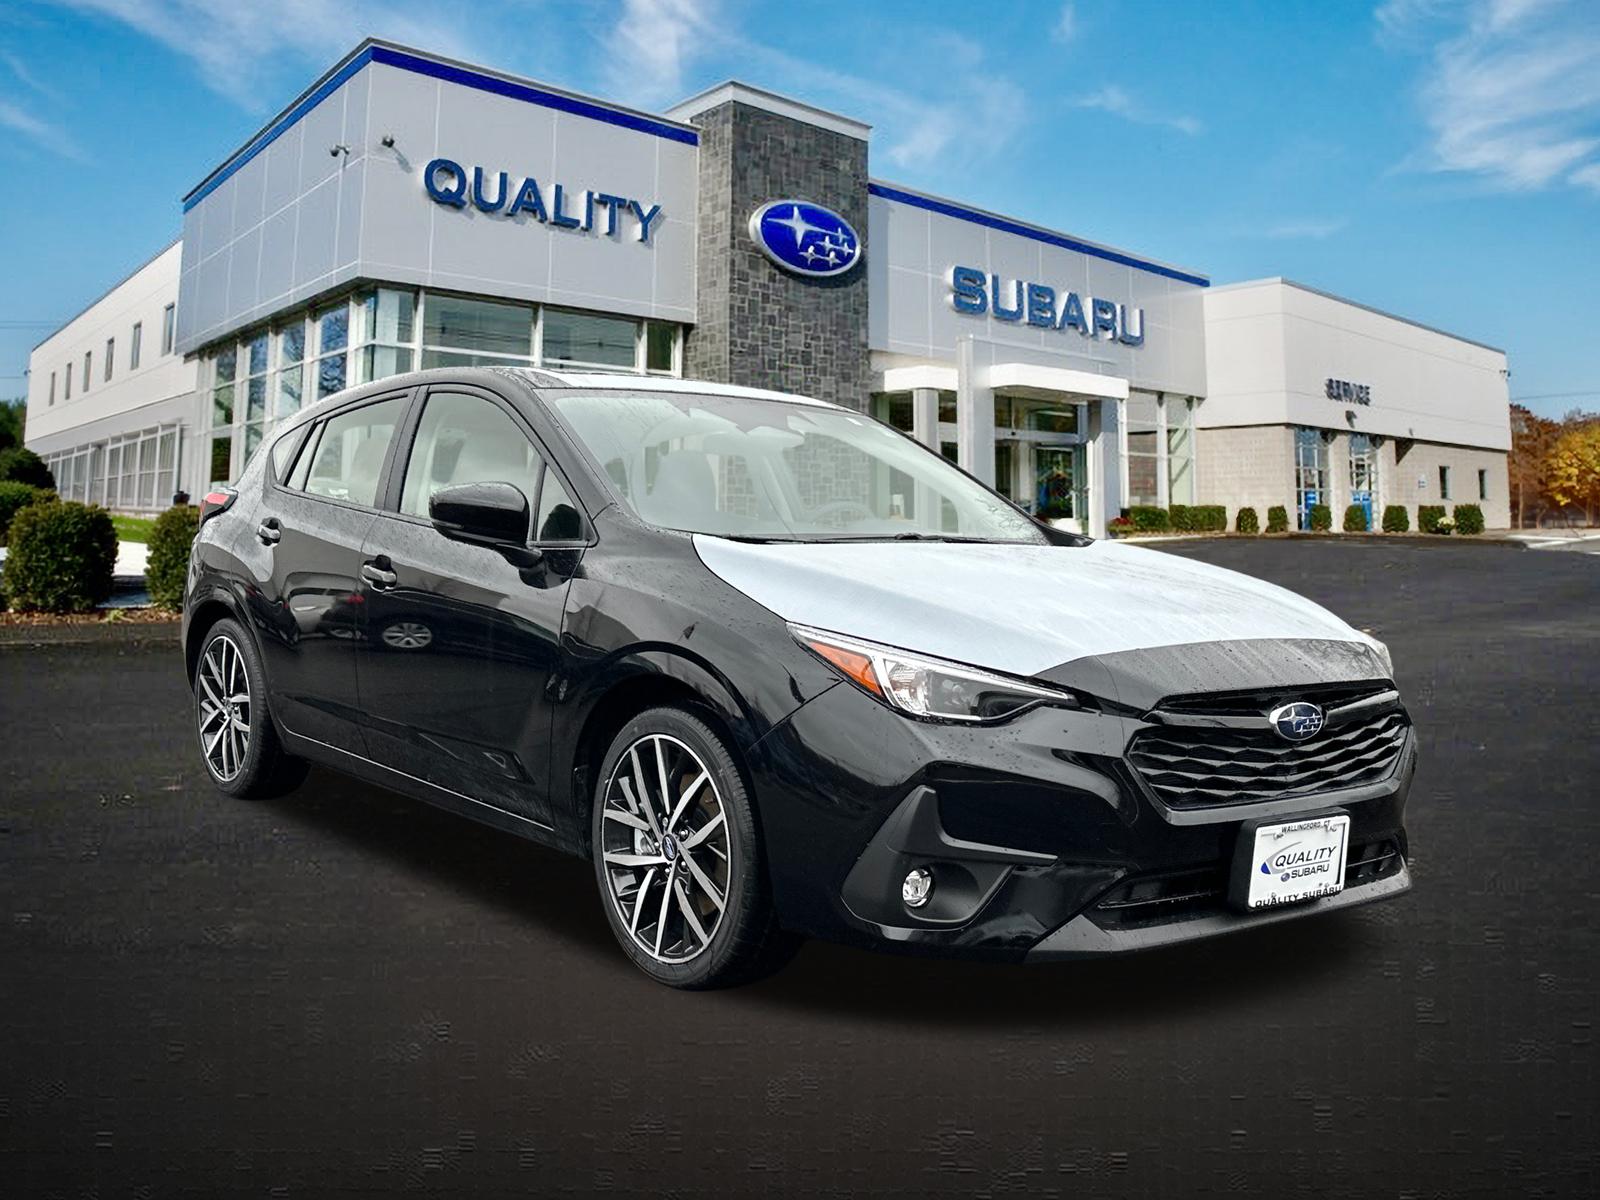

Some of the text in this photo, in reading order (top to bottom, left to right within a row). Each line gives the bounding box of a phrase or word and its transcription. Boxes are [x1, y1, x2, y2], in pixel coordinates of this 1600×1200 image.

[424, 158, 661, 242] QUALITY
[952, 265, 1145, 347] SUBARU
[1325, 378, 1370, 406] SERVICE
[1275, 846, 1337, 867] QUALITY
[1291, 864, 1330, 879] SUBARU
[1255, 885, 1342, 908] QUALITY SUBARU
